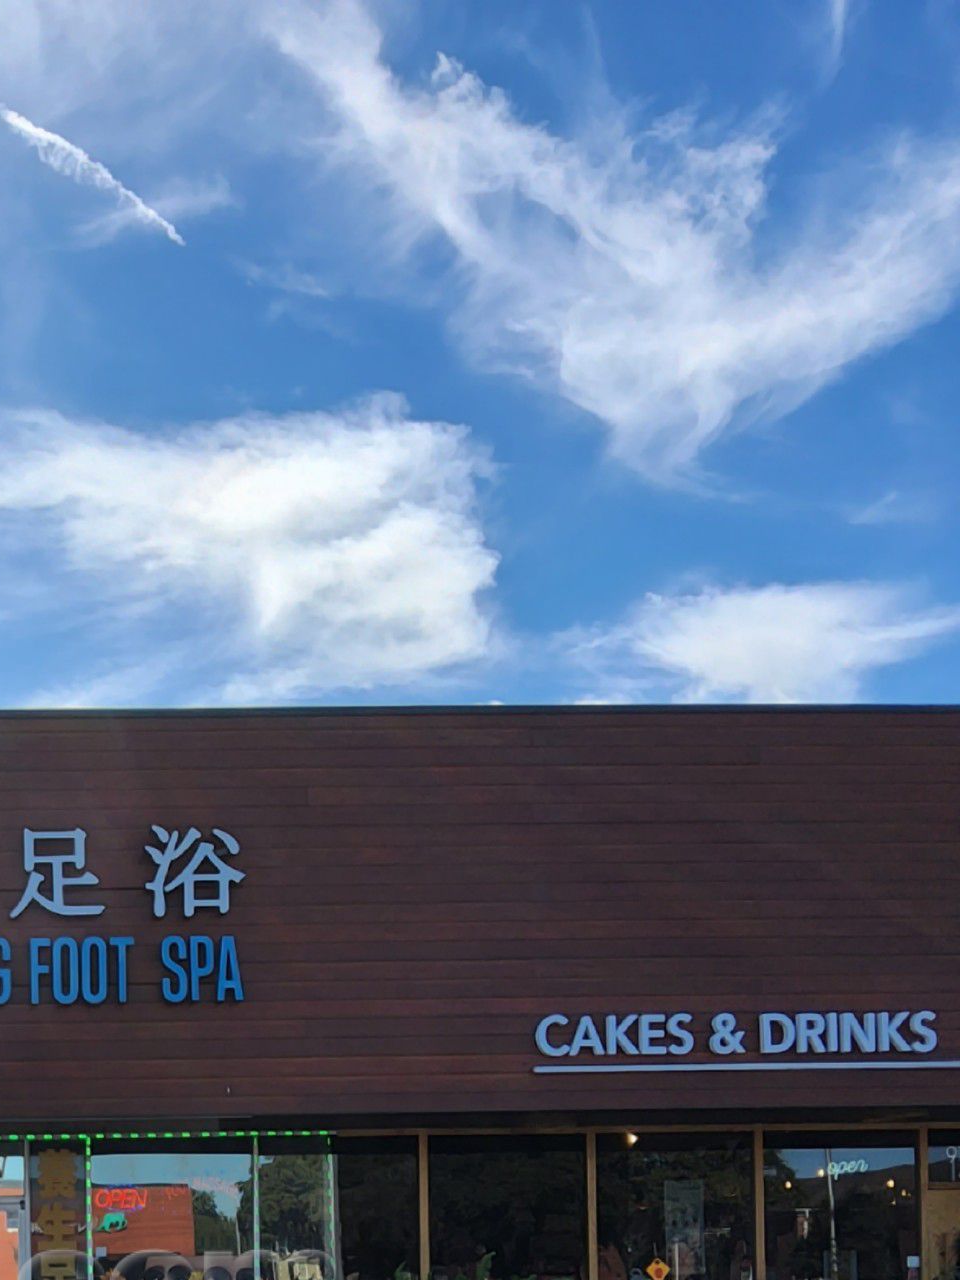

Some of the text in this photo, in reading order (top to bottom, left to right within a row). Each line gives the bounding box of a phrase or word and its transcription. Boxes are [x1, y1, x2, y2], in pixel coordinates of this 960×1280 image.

[30, 936, 134, 1004] FOOT
[161, 935, 244, 1002] SPA
[535, 1010, 938, 1057] CAKES & DRINKS
[826, 1158, 869, 1180] open
[95, 1188, 148, 1209] OPEN
